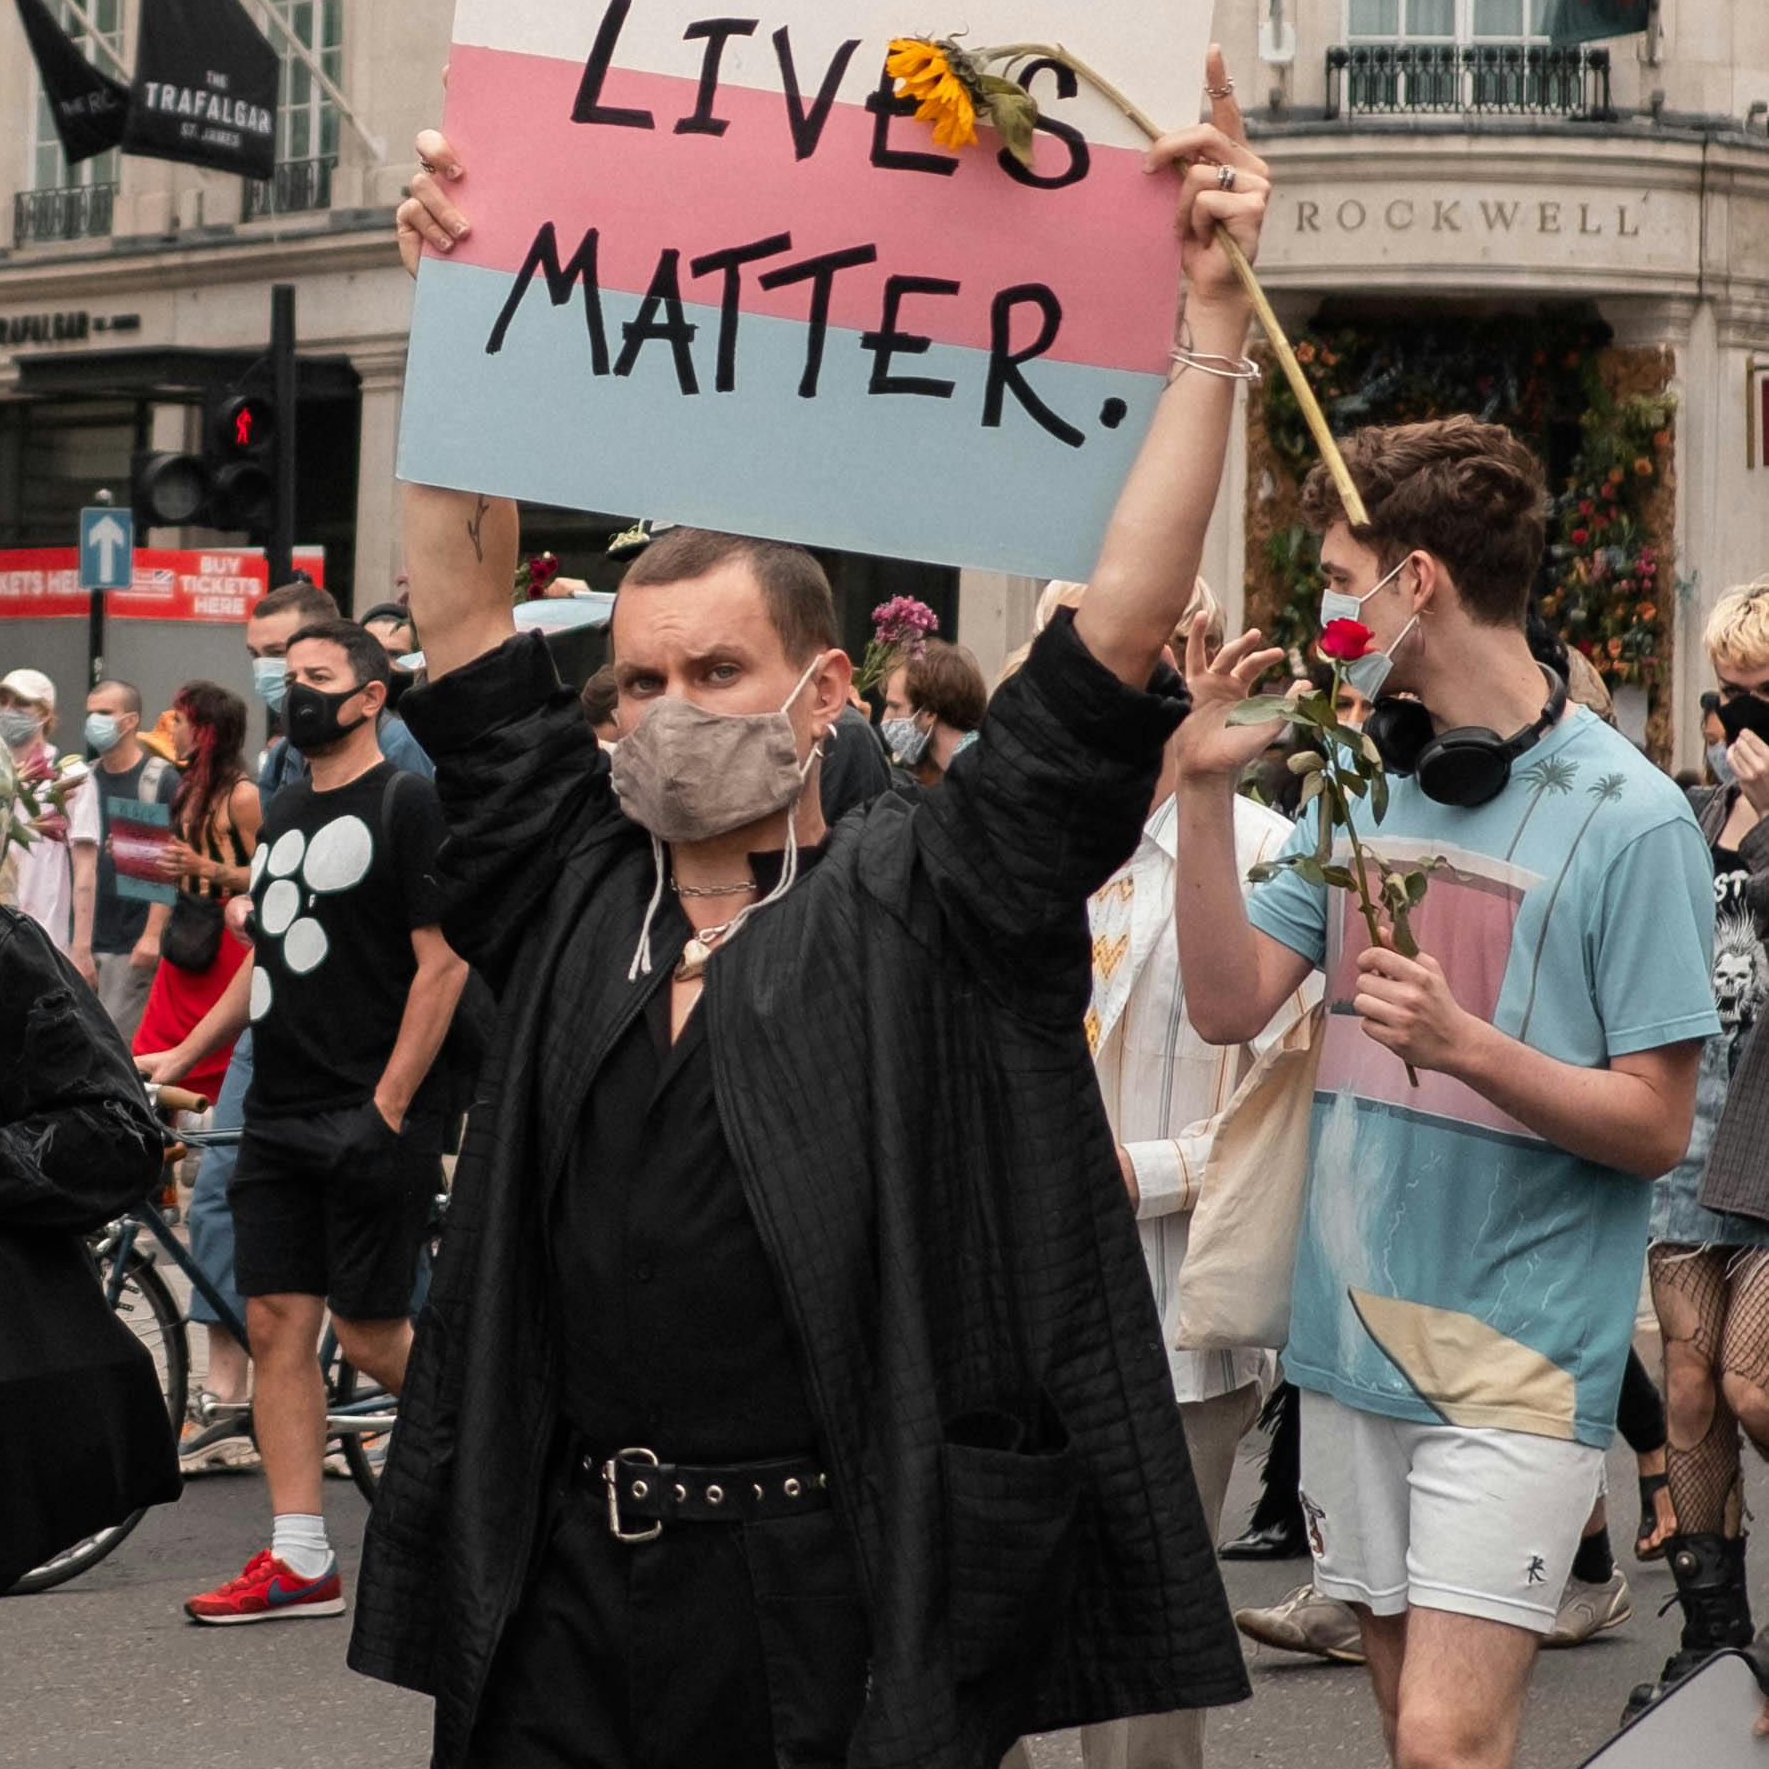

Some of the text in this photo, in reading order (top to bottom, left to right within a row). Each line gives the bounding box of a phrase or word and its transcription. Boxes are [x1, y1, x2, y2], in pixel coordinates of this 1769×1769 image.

[145, 81, 272, 134] TRAFALGAR
[1295, 198, 1639, 236] ROCKWELL
[486, 221, 1127, 448] MATTER.
[200, 555, 241, 574] BUY
[180, 574, 261, 596] TICKETS
[193, 596, 246, 615] HERE
